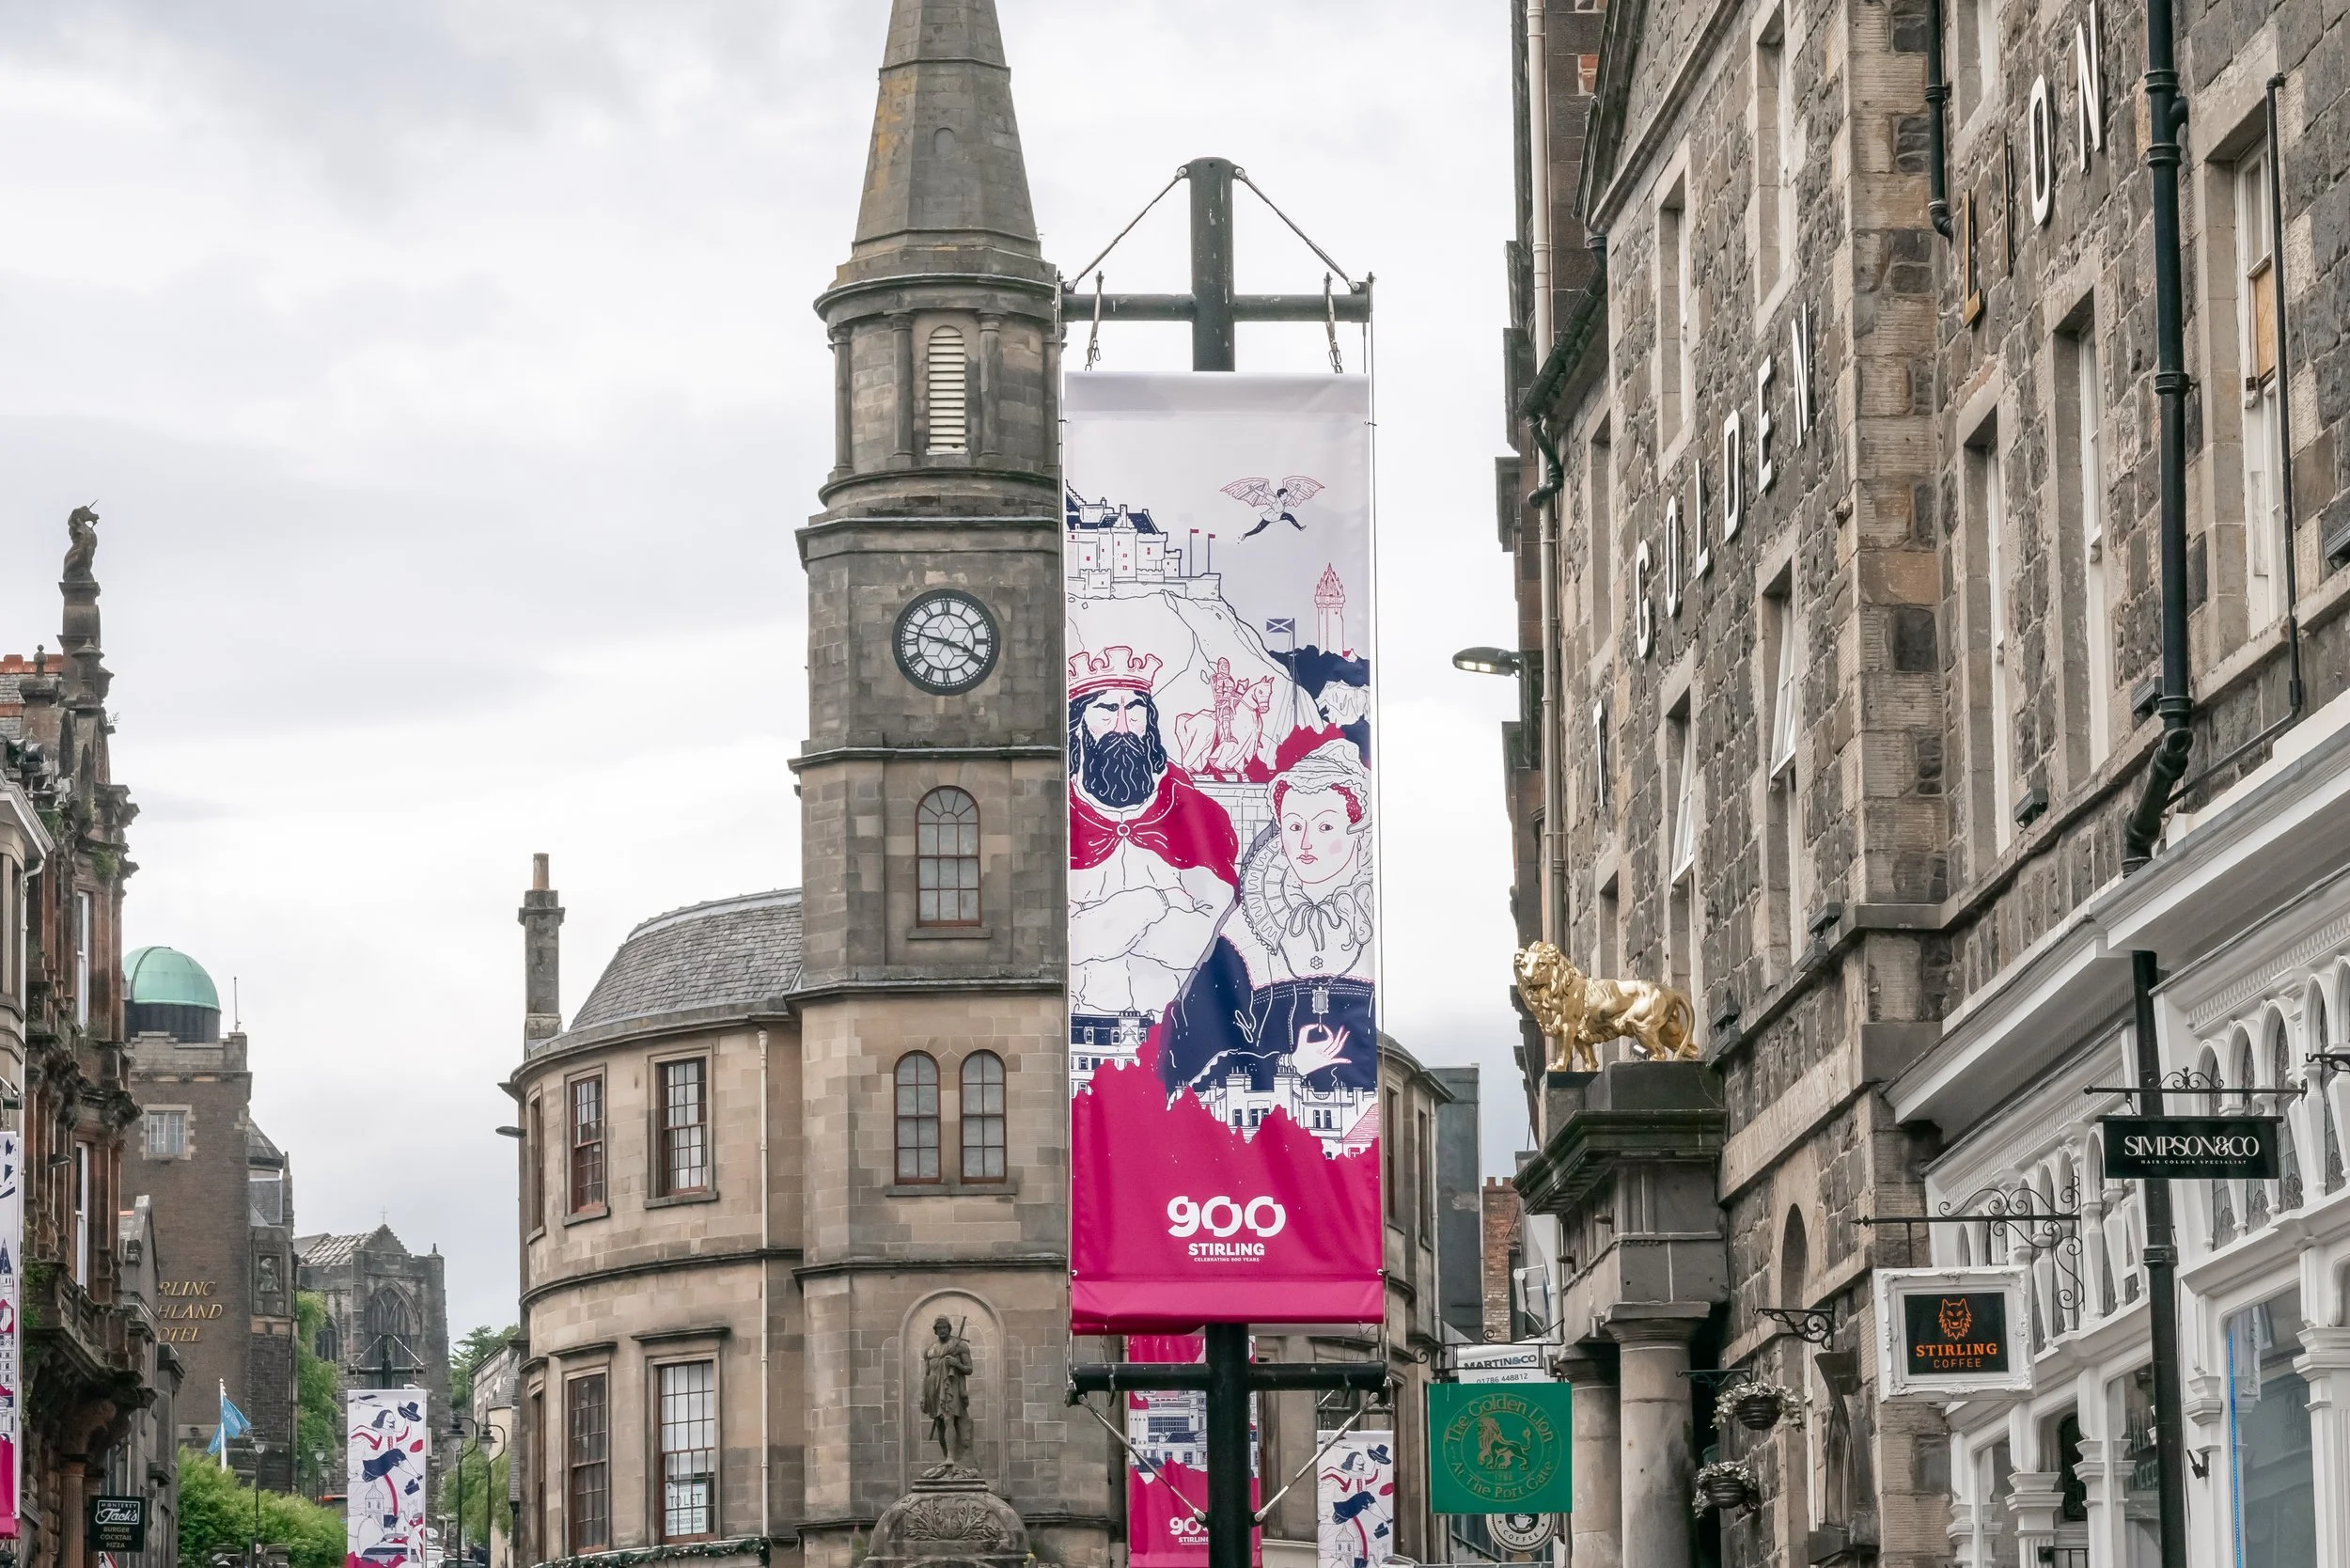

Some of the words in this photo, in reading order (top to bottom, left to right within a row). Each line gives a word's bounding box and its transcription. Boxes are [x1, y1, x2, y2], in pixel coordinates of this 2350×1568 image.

[1636, 302, 1810, 659] GOLDEN
[1963, 0, 2102, 329] LION
[2124, 1136, 2260, 1157] SIMPSON&CO
[1167, 1195, 1287, 1238] 900
[1188, 1242, 1265, 1256] STIRLING
[158, 1304, 223, 1320] HLAND
[159, 1327, 202, 1342] OTEL
[1916, 1342, 1998, 1357] STIRLING
[1934, 1358, 1982, 1369] COFFEE
[1445, 1415, 1469, 1445] The
[1468, 1396, 1528, 1418] Golden
[1528, 1406, 1555, 1443] Lion
[1466, 1475, 1492, 1497] The
[1495, 1485, 1525, 1498] Port
[1526, 1460, 1554, 1490] Gate
[95, 1508, 138, 1524] Jack's
[1169, 1516, 1209, 1535] 90
[1503, 1529, 1540, 1542] COFFEE
